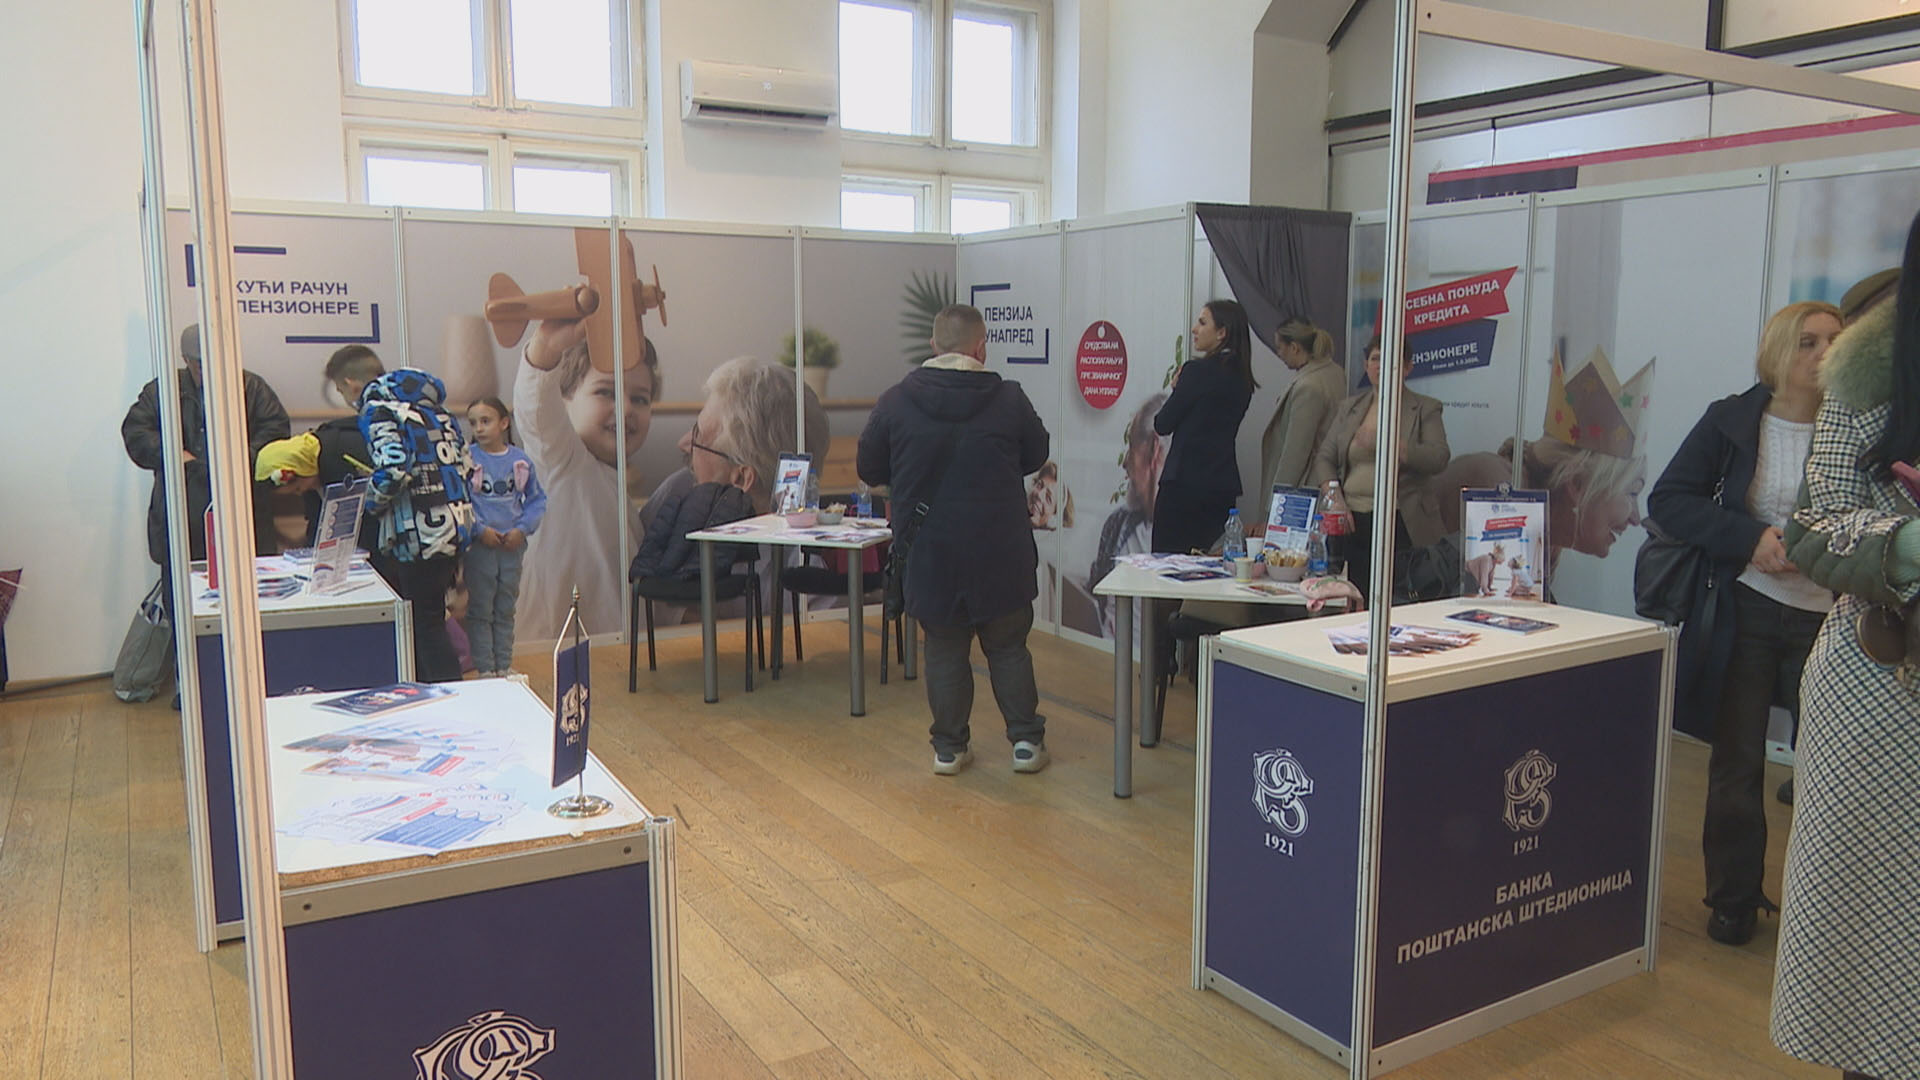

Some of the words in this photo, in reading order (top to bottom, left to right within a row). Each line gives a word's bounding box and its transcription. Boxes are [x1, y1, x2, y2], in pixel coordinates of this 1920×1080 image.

[236, 280, 284, 294] КУЋИ
[291, 281, 348, 295] РАЧУН
[1405, 293, 1445, 310] СЕБНА
[1447, 279, 1500, 301] ПОНУДА
[237, 300, 360, 315] ПЕНЗИОНЕРЕ
[984, 305, 1033, 322] ПЕНЗИЈА
[1413, 304, 1470, 325] КРЕДИТА
[985, 328, 1034, 346] УНАПРЕД
[1411, 342, 1478, 365] ЕНЗИОНЕРЕ
[1264, 832, 1294, 857] 1921
[1512, 834, 1540, 856] 1921
[1495, 871, 1553, 905] БАНКА
[1396, 909, 1514, 965] ПОШТАНСКА
[1518, 868, 1633, 923] ШТЕДИОНИЦА
